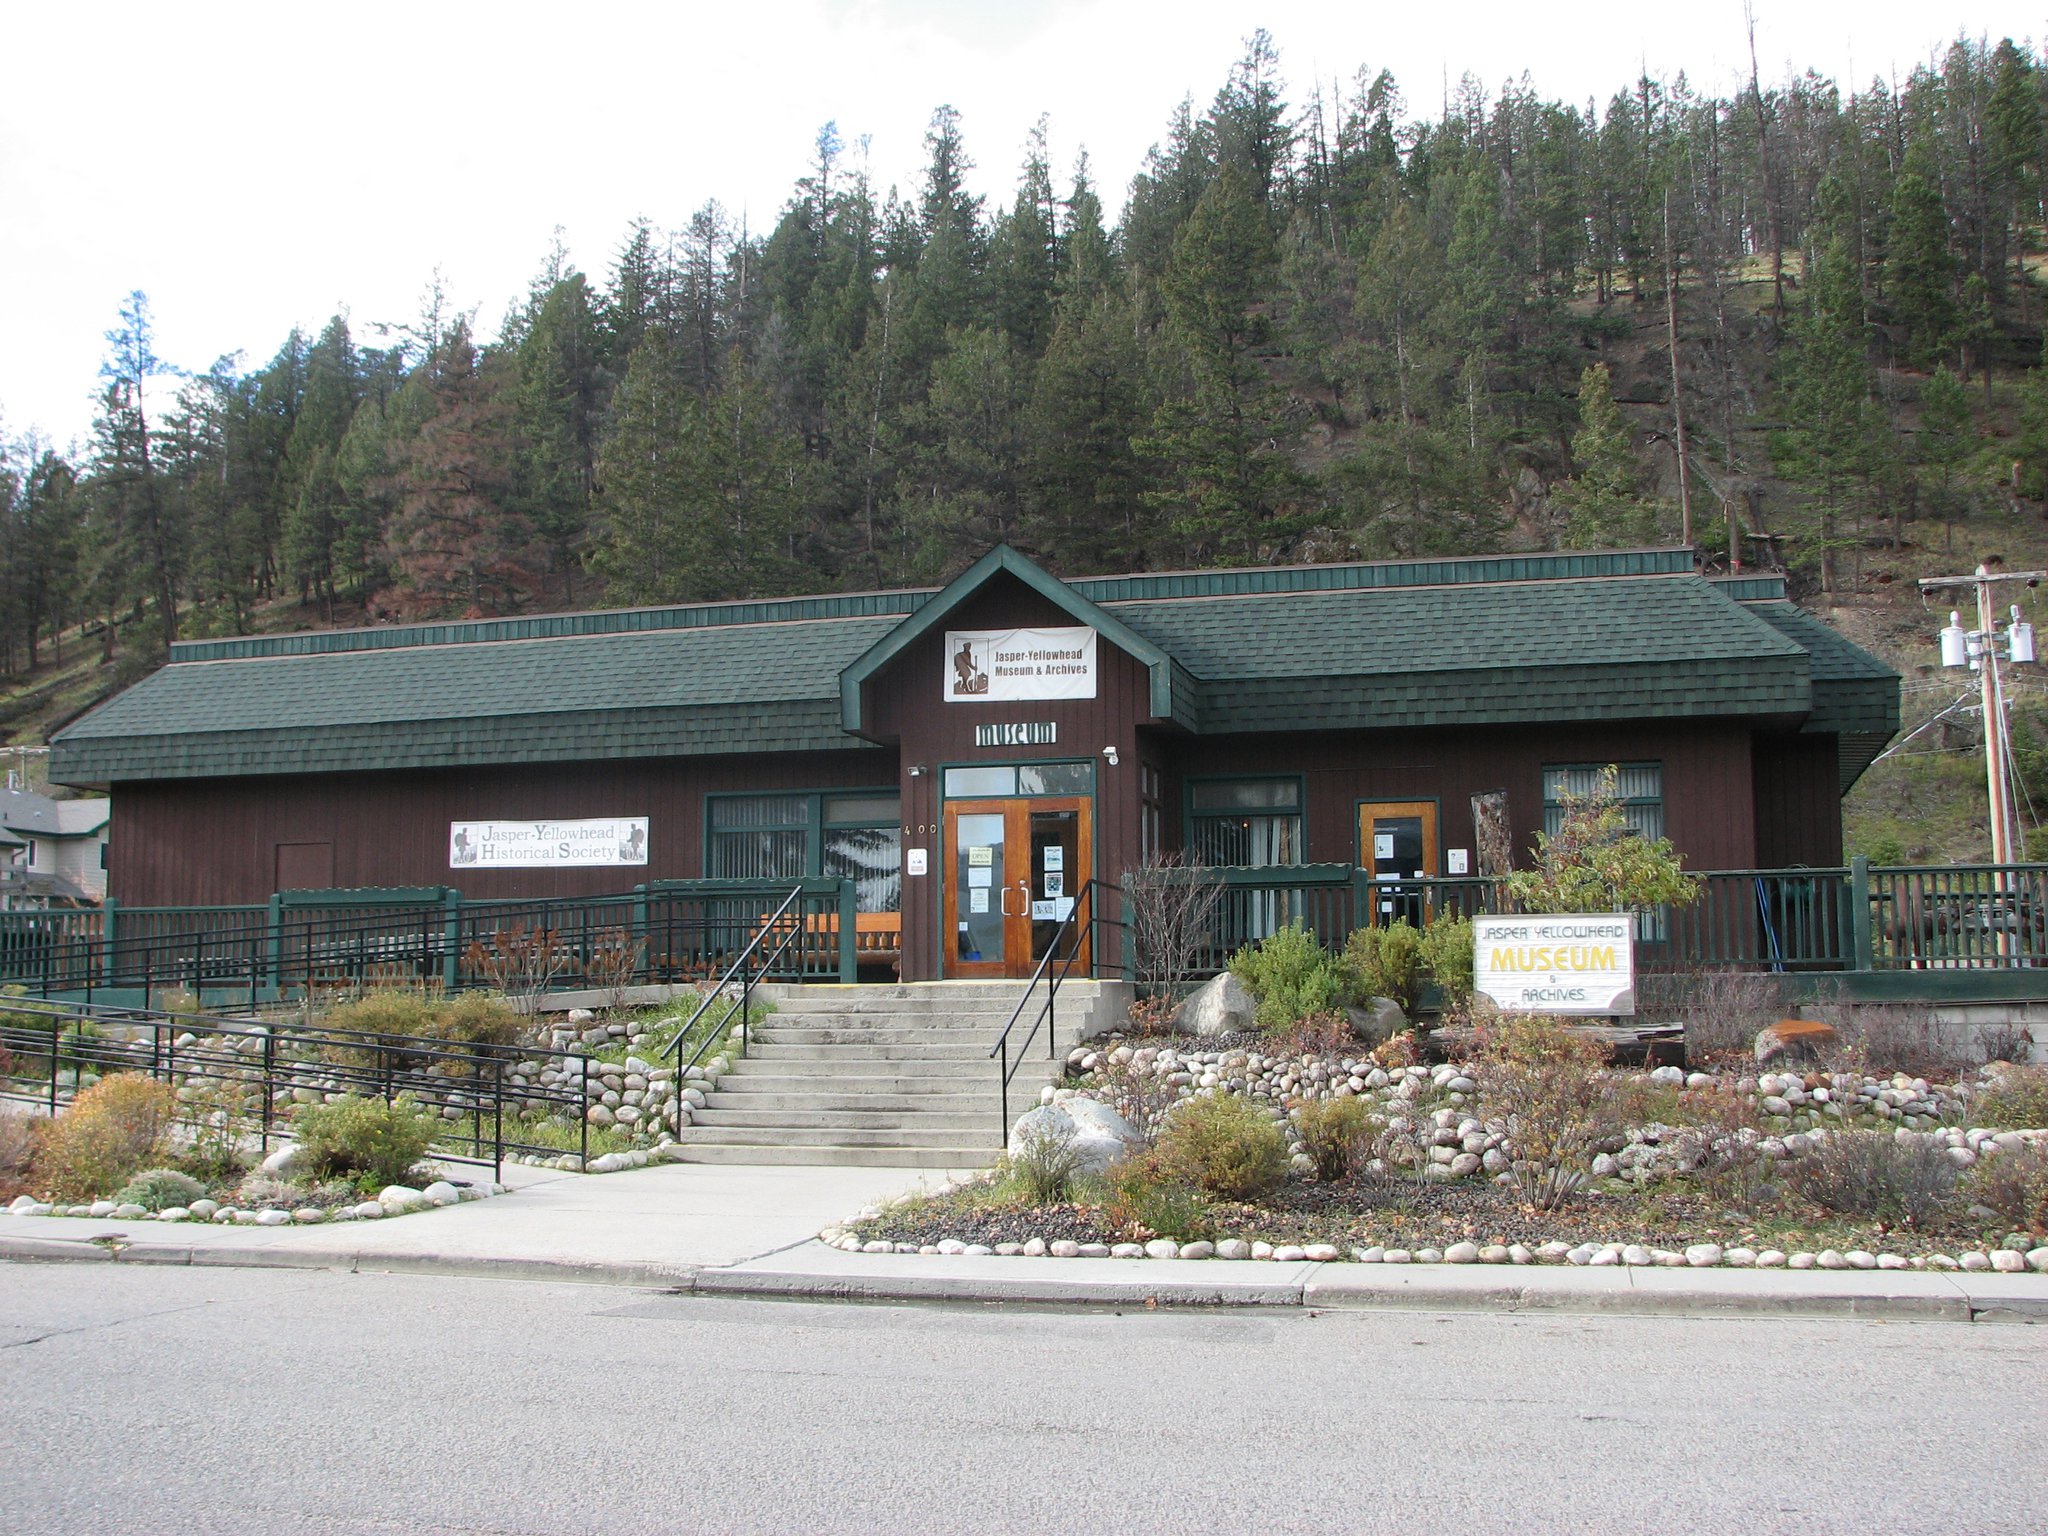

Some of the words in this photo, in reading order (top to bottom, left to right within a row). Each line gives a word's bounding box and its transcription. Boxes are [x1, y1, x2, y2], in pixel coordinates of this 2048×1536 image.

[995, 649, 1083, 662] Jasper-Yellowhead
[995, 664, 1034, 676] Museum
[1036, 665, 1042, 675] &
[1045, 664, 1088, 675] Archives
[979, 723, 1053, 745] museum
[482, 825, 614, 846] Jasper-Yellowhead
[482, 844, 555, 860] Historical
[559, 843, 616, 860] Society
[1483, 927, 1527, 940] JASPER
[1534, 926, 1624, 939] YELLOWHEAD
[1490, 946, 1616, 972] MUSEUM
[1522, 988, 1585, 1001] ARCHIVES
